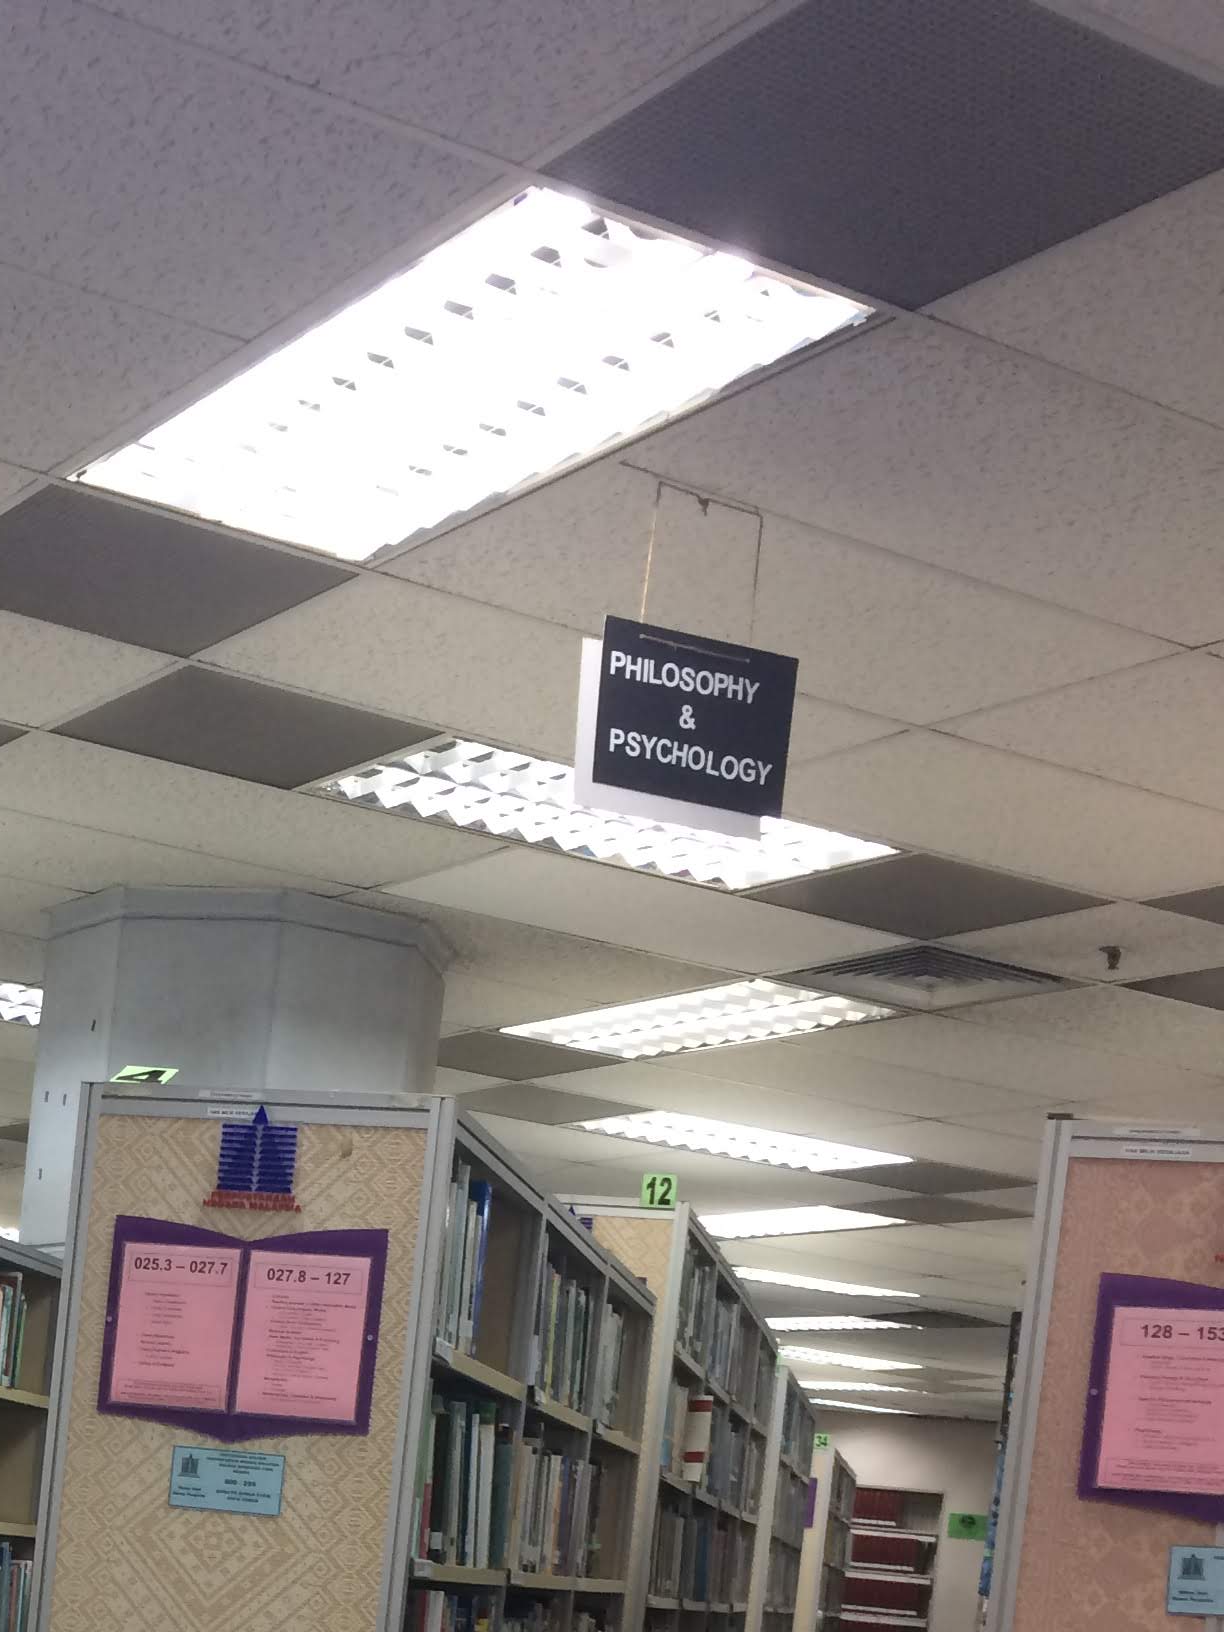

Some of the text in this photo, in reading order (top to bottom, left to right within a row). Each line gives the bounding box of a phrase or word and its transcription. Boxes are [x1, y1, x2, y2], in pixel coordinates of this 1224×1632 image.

[609, 650, 760, 704] PHILOSOPHY
[679, 705, 696, 730] &
[609, 728, 773, 785] PSYCHOLOGY
[646, 1176, 672, 1205] 12
[134, 1257, 172, 1271] 025.3
[189, 1261, 228, 1276] 027.7
[267, 1268, 306, 1283] 027.8
[325, 1272, 351, 1286] 127
[1140, 1324, 1172, 1339] 128
